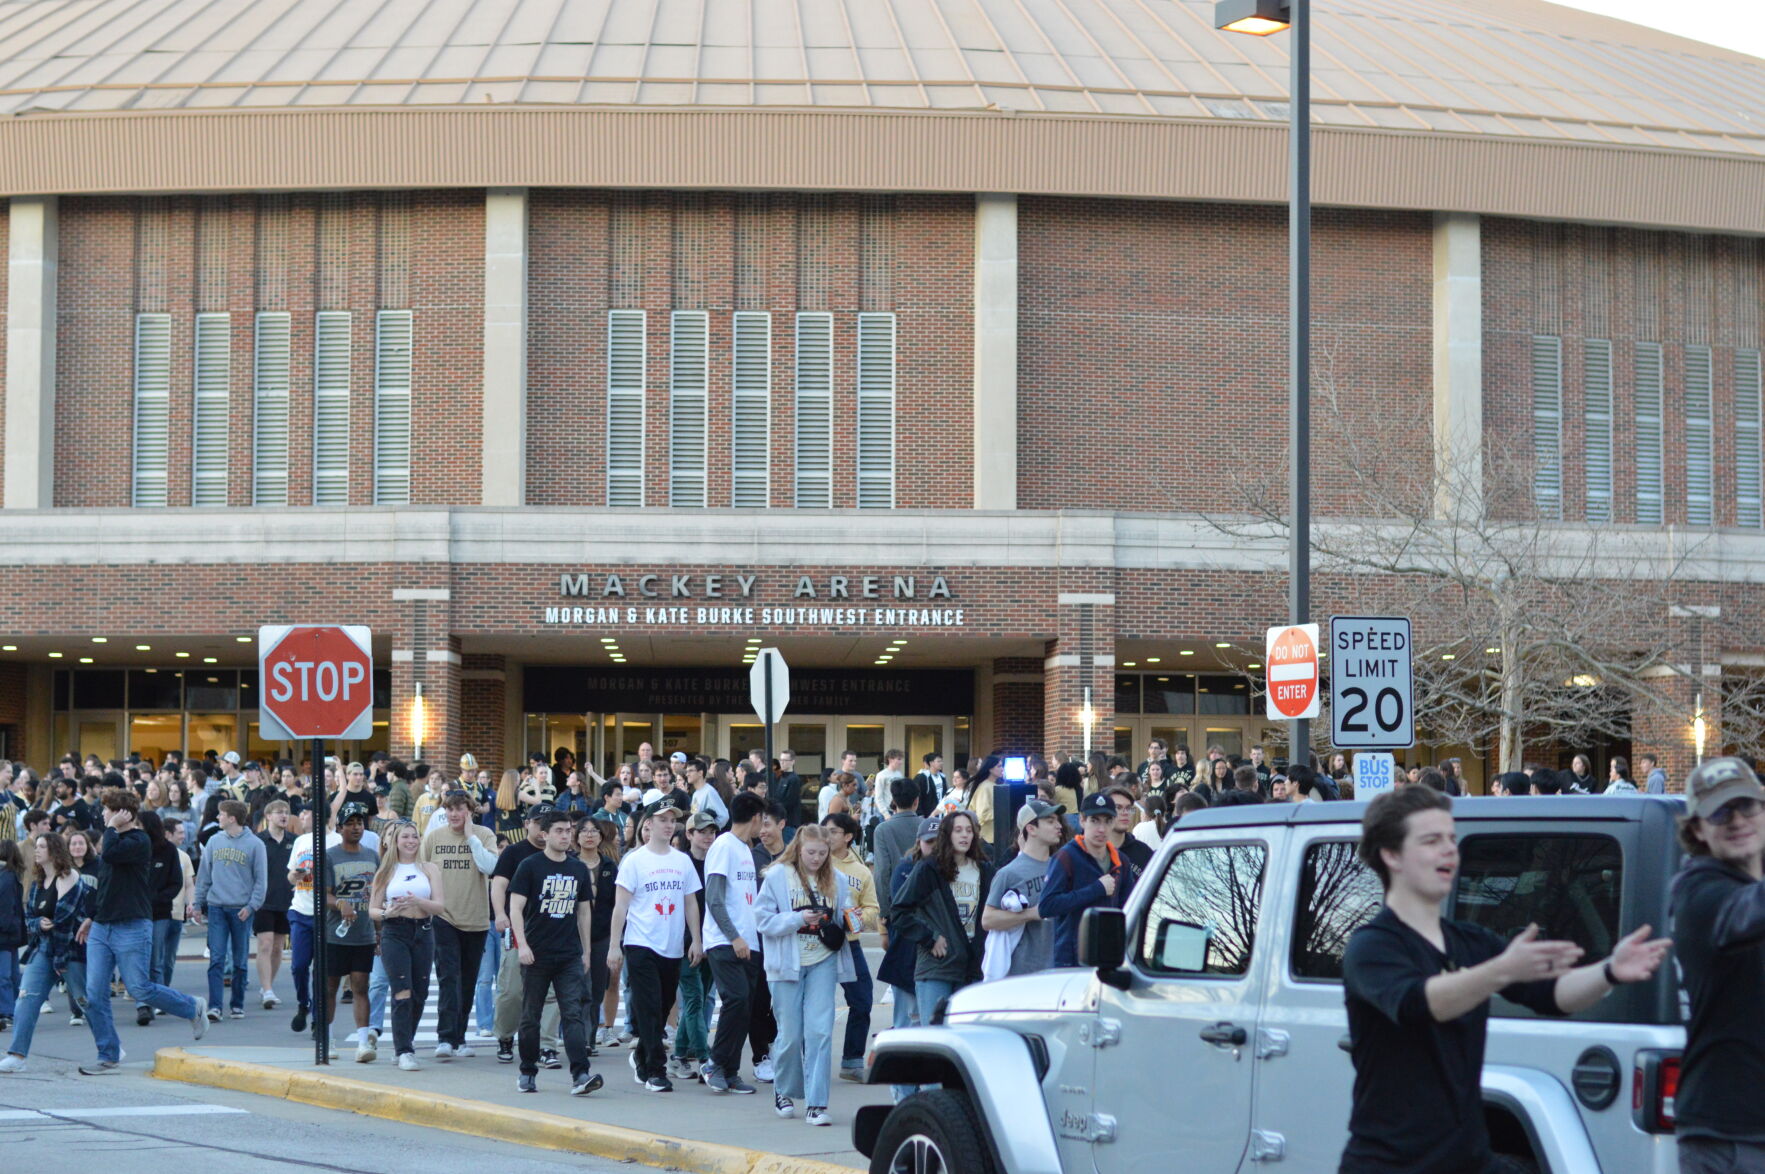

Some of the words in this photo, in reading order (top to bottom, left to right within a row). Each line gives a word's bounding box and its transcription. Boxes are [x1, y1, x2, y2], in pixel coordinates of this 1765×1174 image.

[560, 573, 756, 598] MACKEY
[795, 575, 952, 600] ARENA
[546, 607, 619, 624] MORGAN
[627, 607, 637, 624] &
[646, 608, 688, 624] KATE
[697, 608, 753, 624] BURKE
[762, 608, 867, 625] SOUTHWEST
[875, 609, 964, 626] ENTRANCE
[1338, 632, 1405, 650] SPEED
[1275, 646, 1288, 660] DO
[1292, 644, 1309, 659] NOT
[1346, 659, 1398, 677] LIMIT
[271, 661, 364, 702] STOP
[587, 677, 645, 691] MORGAN
[665, 678, 698, 691] KATE
[703, 679, 748, 691] BURKE
[841, 680, 912, 692] ENTRANCE
[1278, 685, 1307, 700] ENTER
[1340, 687, 1404, 732] 20
[1360, 760, 1389, 775] BUS
[1360, 776, 1389, 788] STOP
[212, 848, 247, 865] PURDUE
[435, 845, 457, 855] CHOO
[458, 845, 473, 855] CH
[443, 860, 470, 869] BITCH
[542, 879, 578, 896] FINAL
[645, 881, 659, 892] BIG
[540, 899, 575, 915] FOUR
[1060, 1109, 1087, 1133] Jeep
